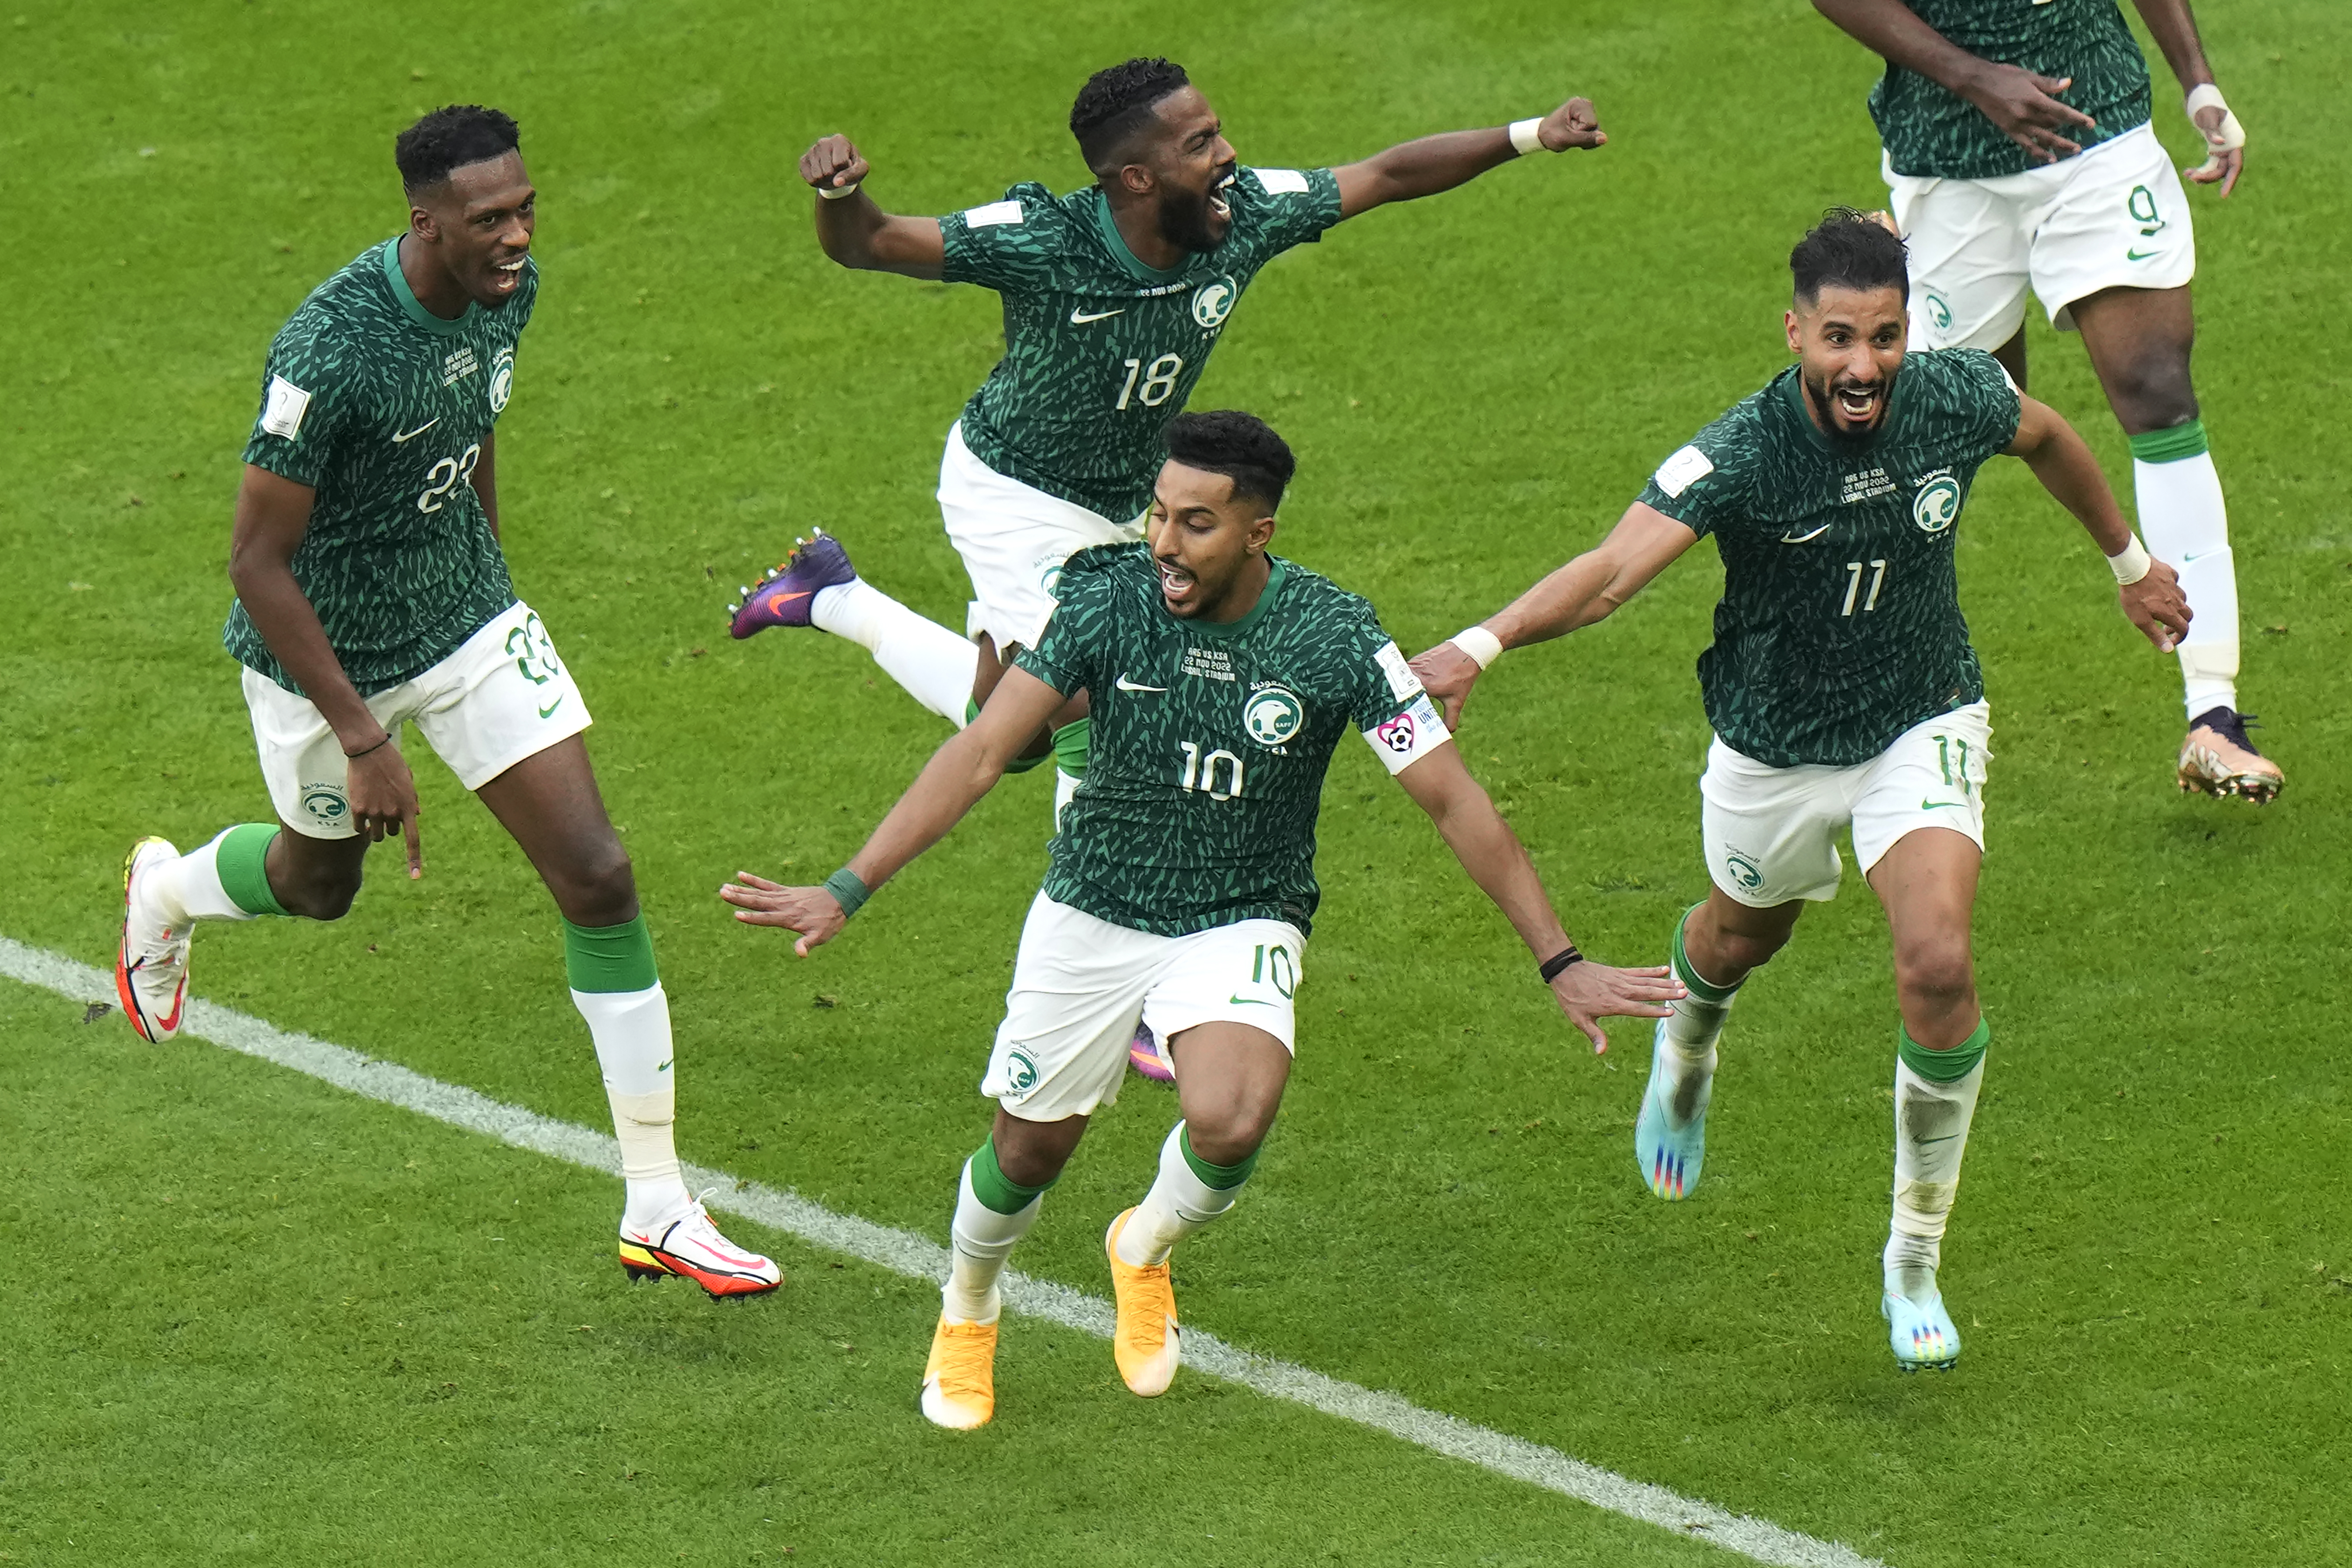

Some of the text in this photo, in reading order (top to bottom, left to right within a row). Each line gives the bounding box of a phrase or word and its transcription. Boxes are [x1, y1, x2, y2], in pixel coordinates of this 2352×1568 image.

[2128, 185, 2166, 236] 9
[1116, 352, 1183, 410] 18
[1869, 476, 1890, 487] 2022
[1841, 559, 1886, 616] 11
[505, 612, 559, 685] 23
[1211, 661, 1231, 671] 2022
[1181, 741, 1243, 801] 10
[1263, 746, 1288, 755] SA
[1932, 735, 1971, 795] 11
[1252, 944, 1294, 1000] 10
